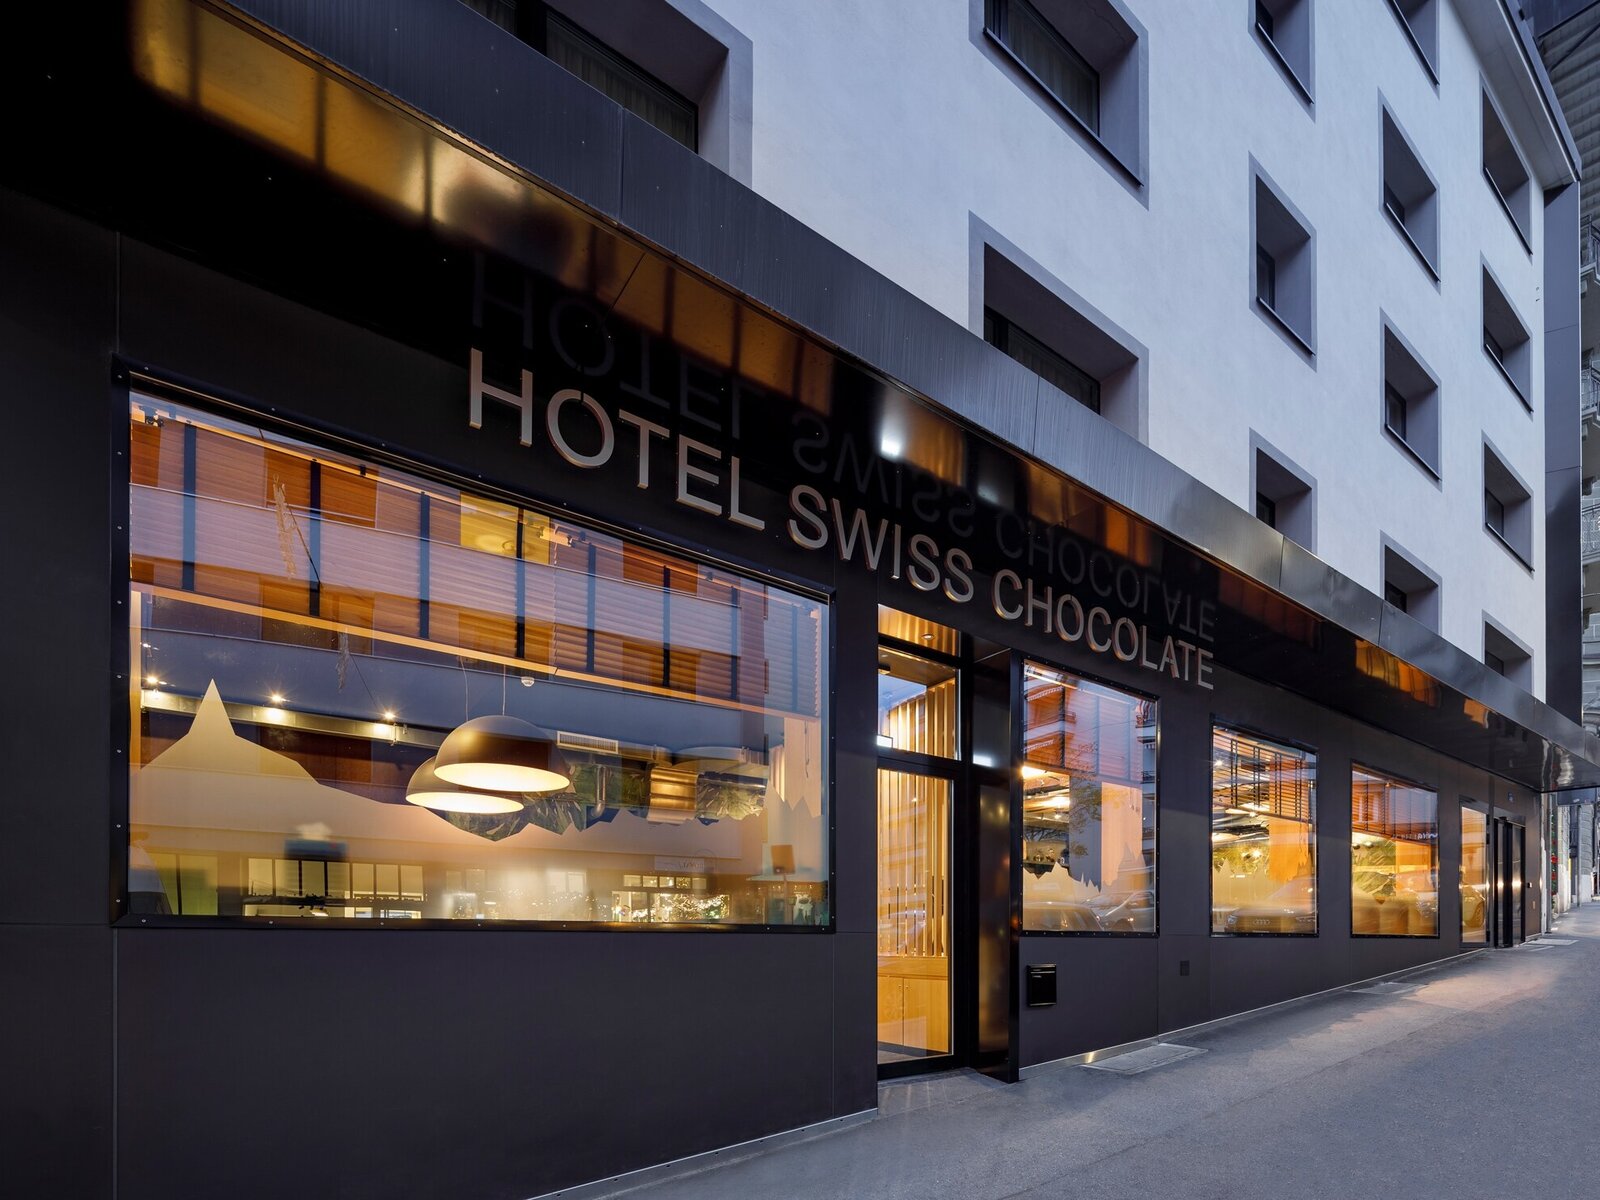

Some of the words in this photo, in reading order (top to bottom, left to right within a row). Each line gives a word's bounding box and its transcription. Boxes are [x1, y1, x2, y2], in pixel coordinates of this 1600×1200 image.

[469, 348, 765, 531] HOTEL
[788, 485, 974, 602] SWISS
[992, 569, 1214, 690] CHOCOLATE
